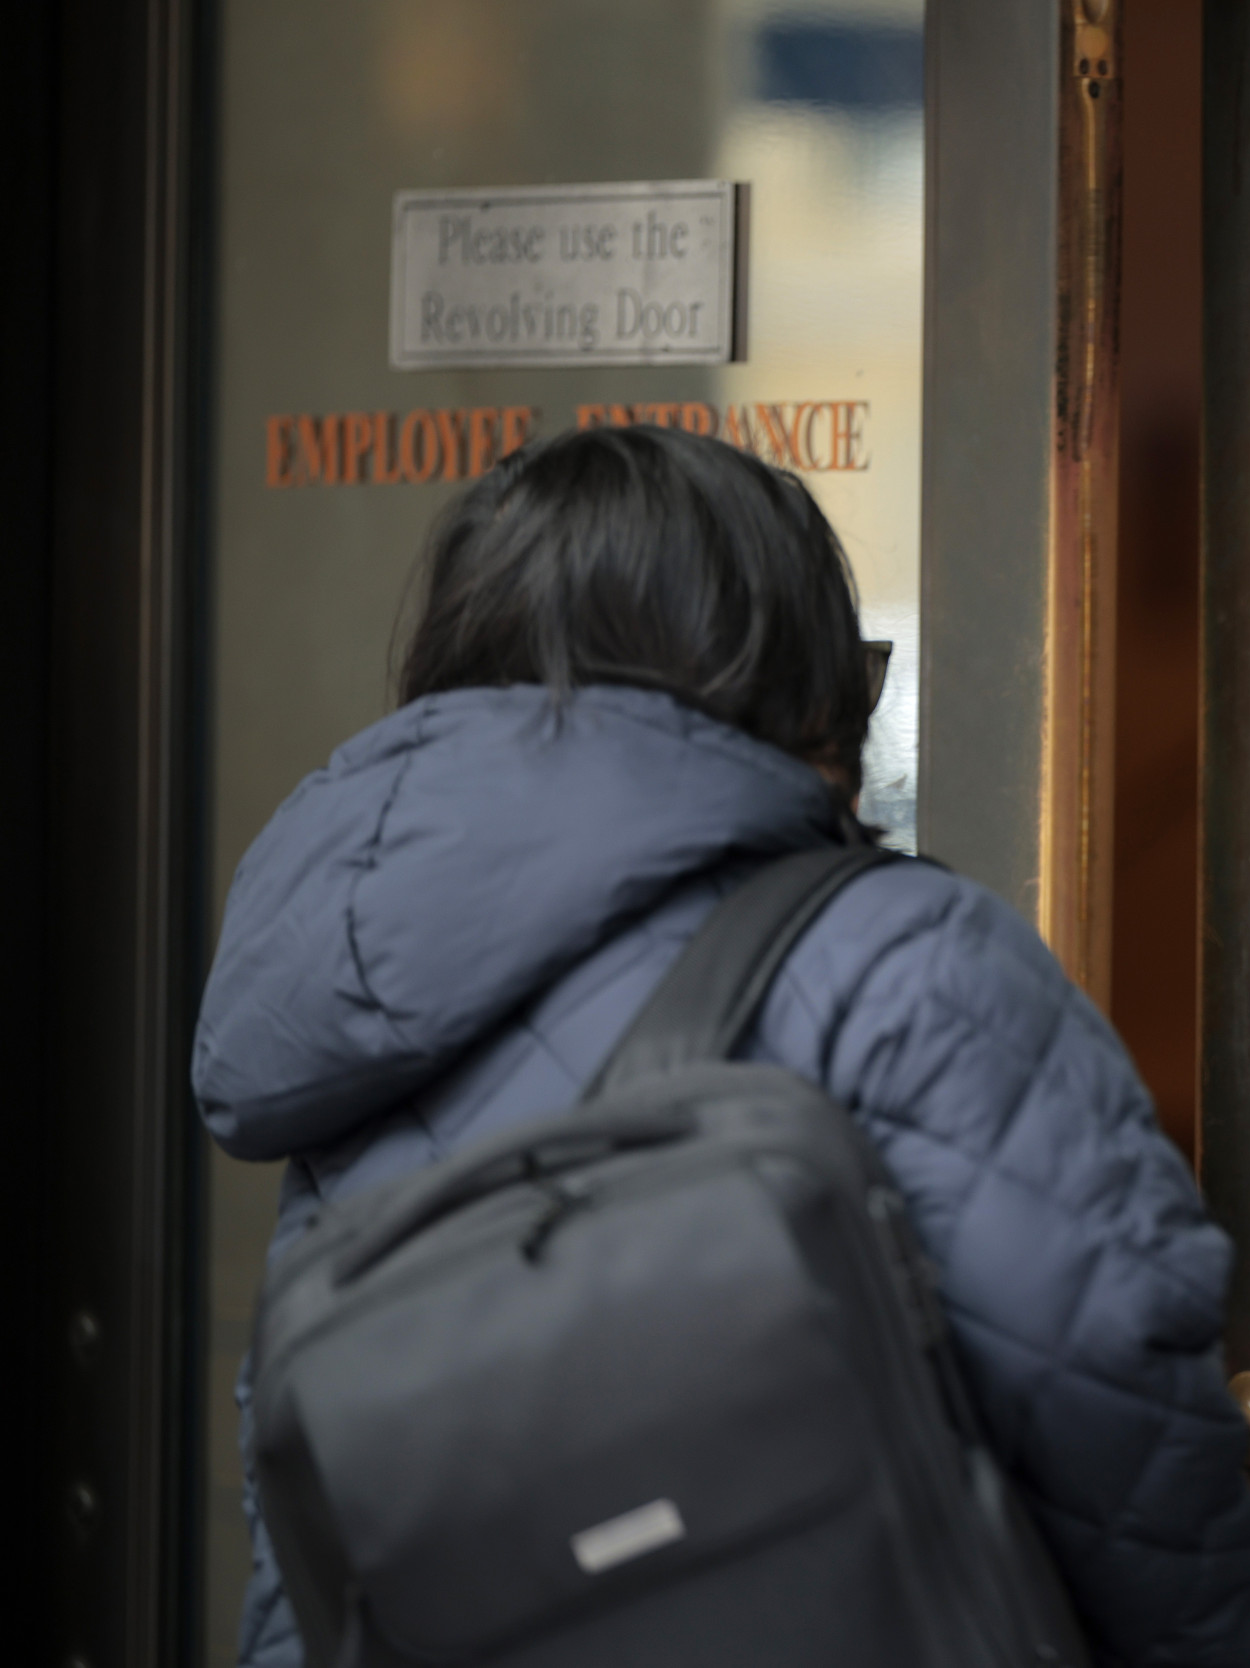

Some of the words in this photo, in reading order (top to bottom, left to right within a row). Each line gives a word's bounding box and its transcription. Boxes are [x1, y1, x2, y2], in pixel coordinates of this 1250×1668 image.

[437, 213, 546, 267] Please
[557, 220, 617, 263] use
[630, 208, 689, 260] the
[419, 289, 601, 352] Revolving
[614, 286, 704, 341] Door
